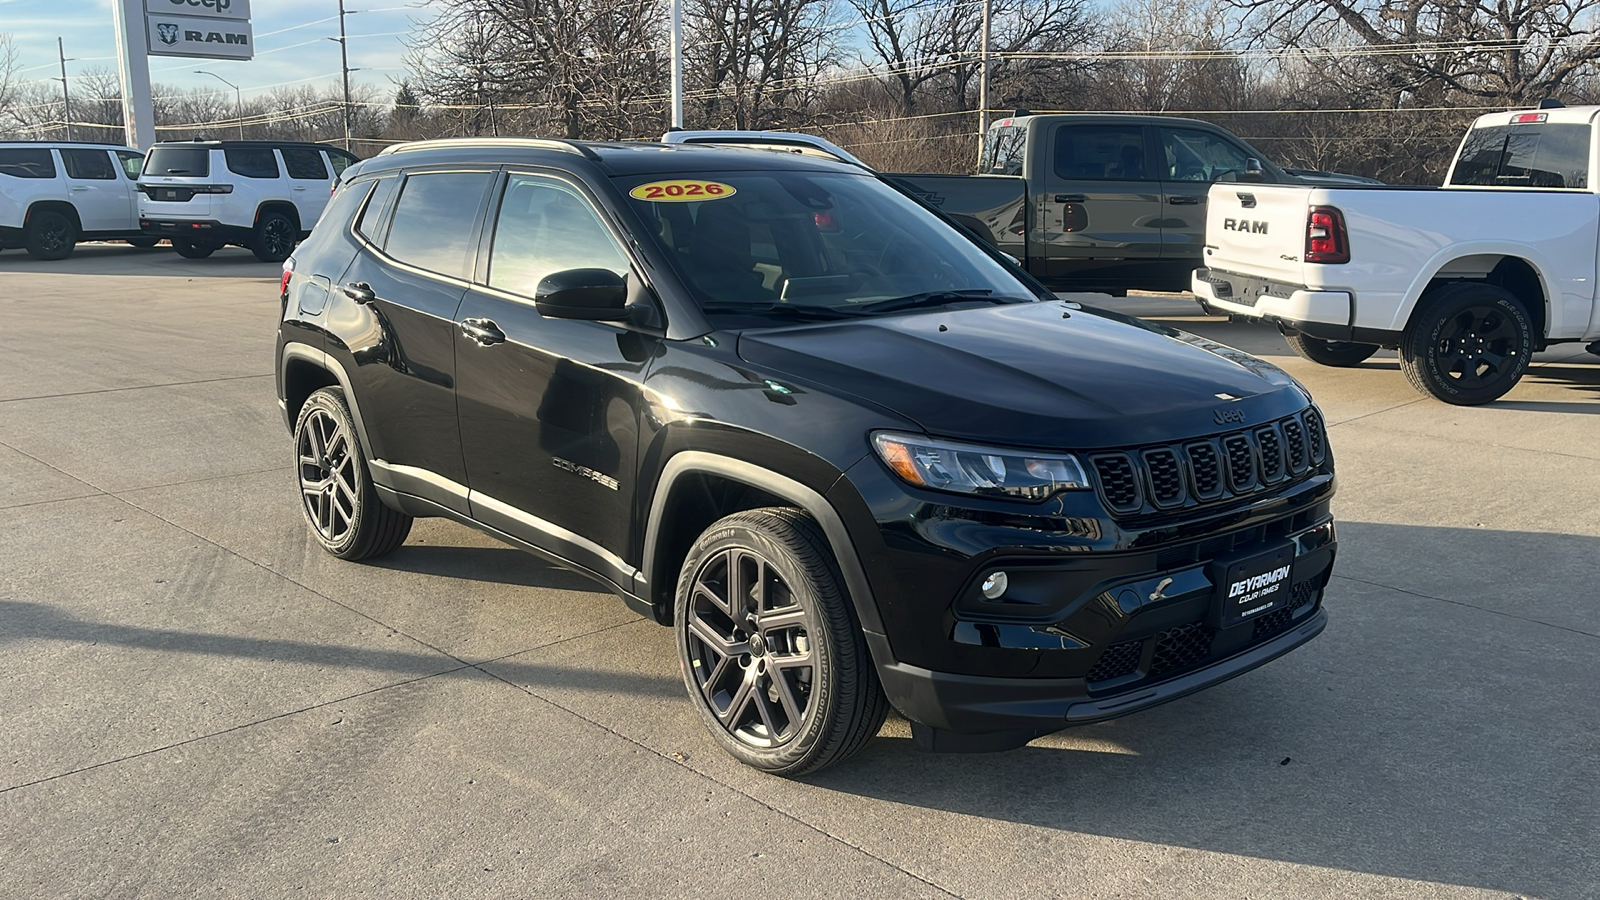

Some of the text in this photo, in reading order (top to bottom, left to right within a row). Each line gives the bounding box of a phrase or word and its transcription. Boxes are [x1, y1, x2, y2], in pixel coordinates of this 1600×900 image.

[170, 0, 230, 12] ep
[184, 30, 248, 45] RAM
[644, 183, 725, 199] 2026
[1224, 217, 1269, 235] RAM
[1212, 408, 1246, 425] Jeep
[551, 456, 621, 491] COMPASS
[1228, 564, 1291, 598] DEYARMAN
[1260, 583, 1280, 597] AMES
[810, 626, 829, 737] ContiProContact
